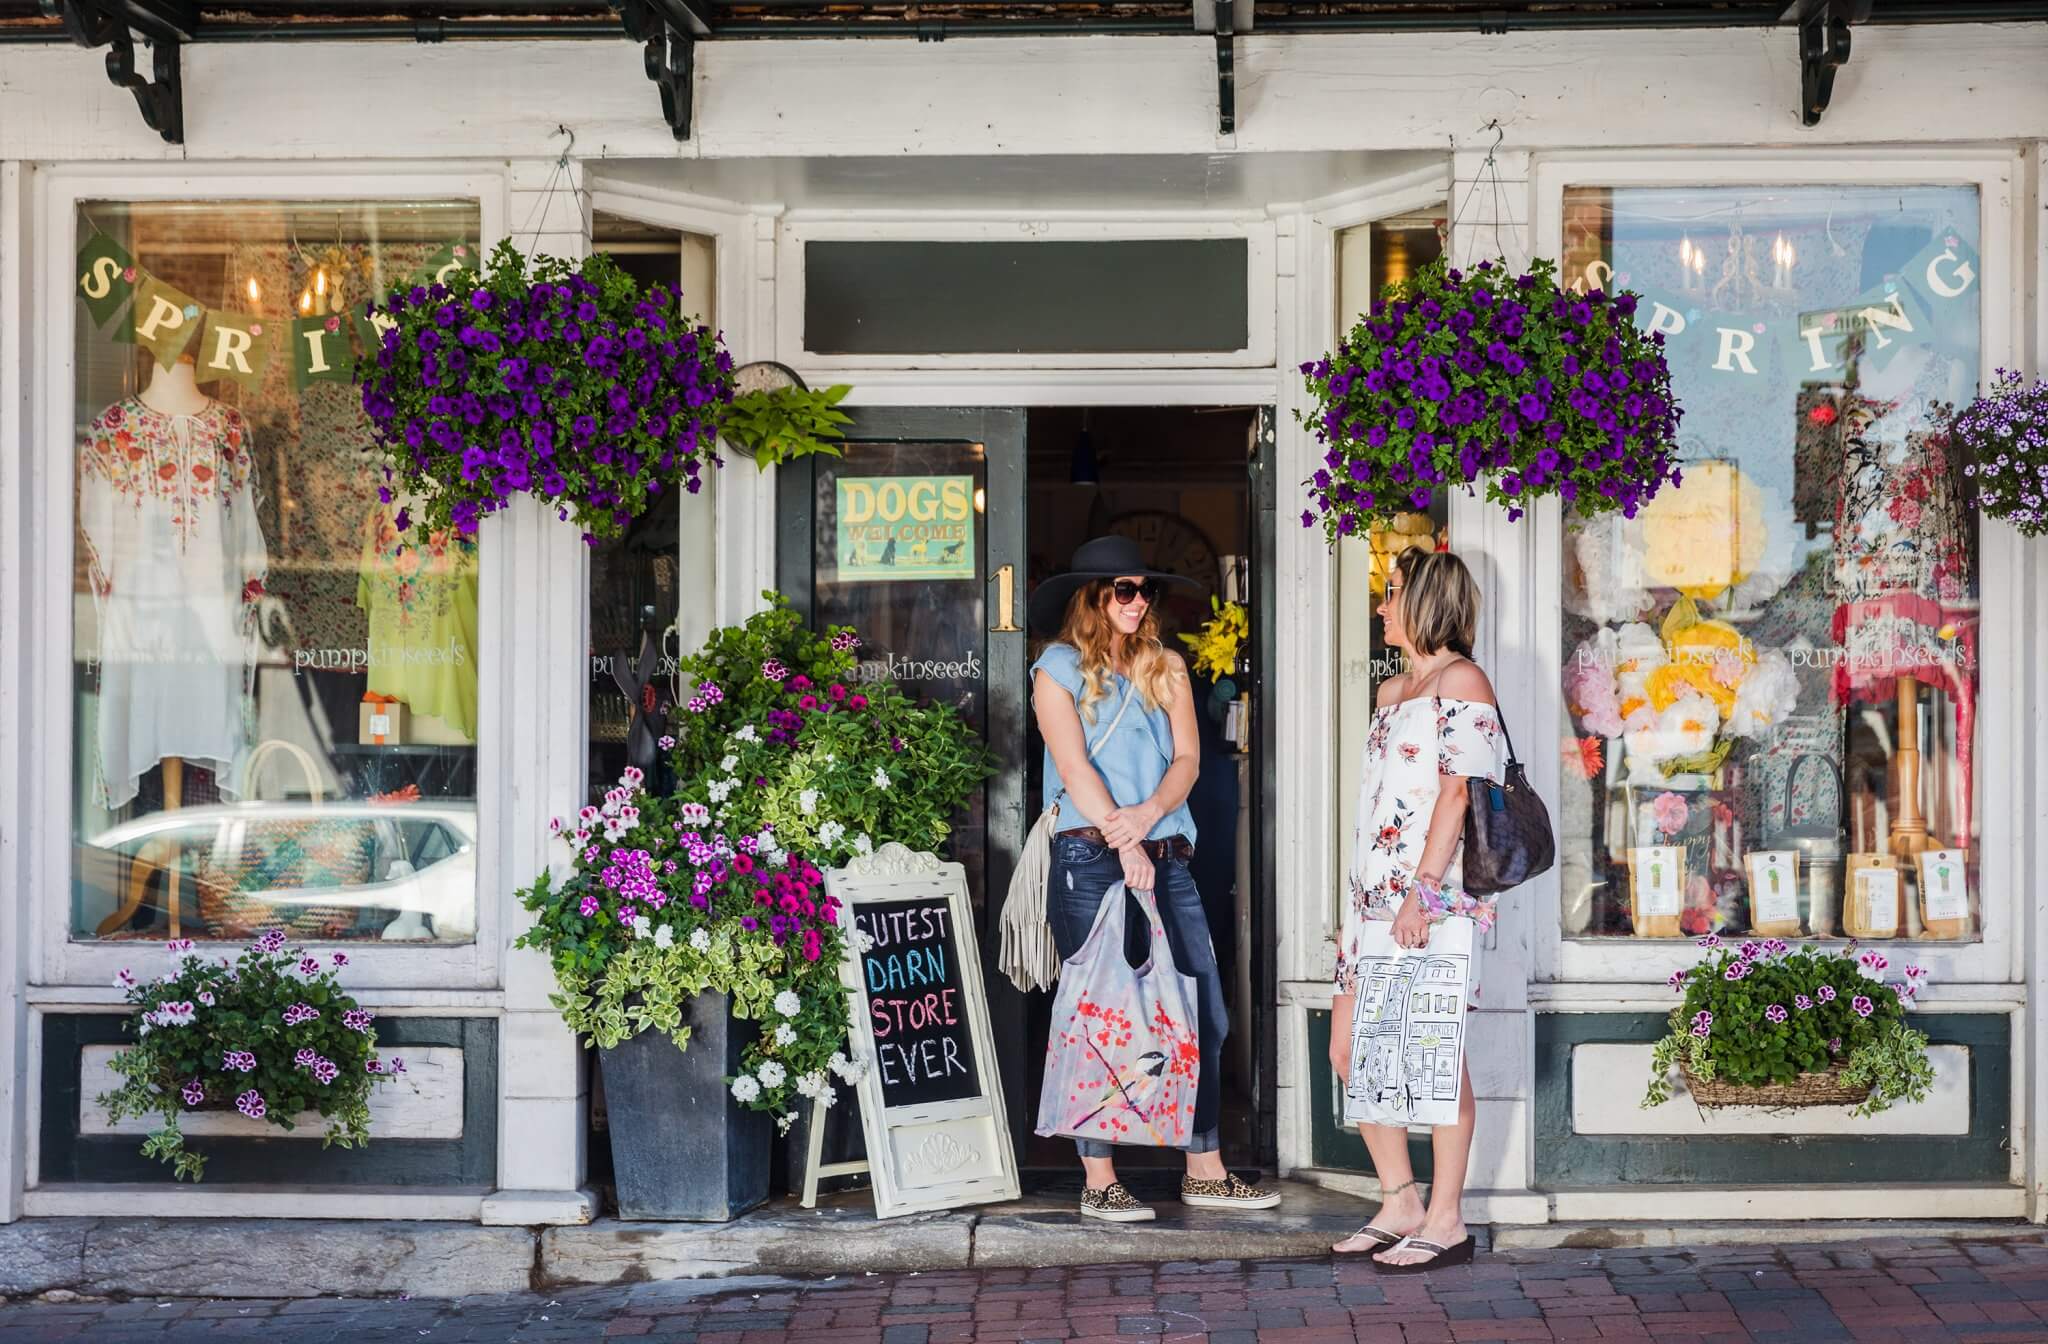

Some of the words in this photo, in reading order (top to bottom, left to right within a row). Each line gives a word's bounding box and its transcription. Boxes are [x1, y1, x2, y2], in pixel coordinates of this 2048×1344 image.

[842, 480, 969, 524] DOGS
[848, 523, 966, 542] WELCOME
[988, 563, 1022, 633] 1
[1576, 634, 1754, 676] puinseeds
[866, 944, 945, 993] DARN
[871, 988, 957, 1037] STORE
[879, 1036, 967, 1085] EVER
